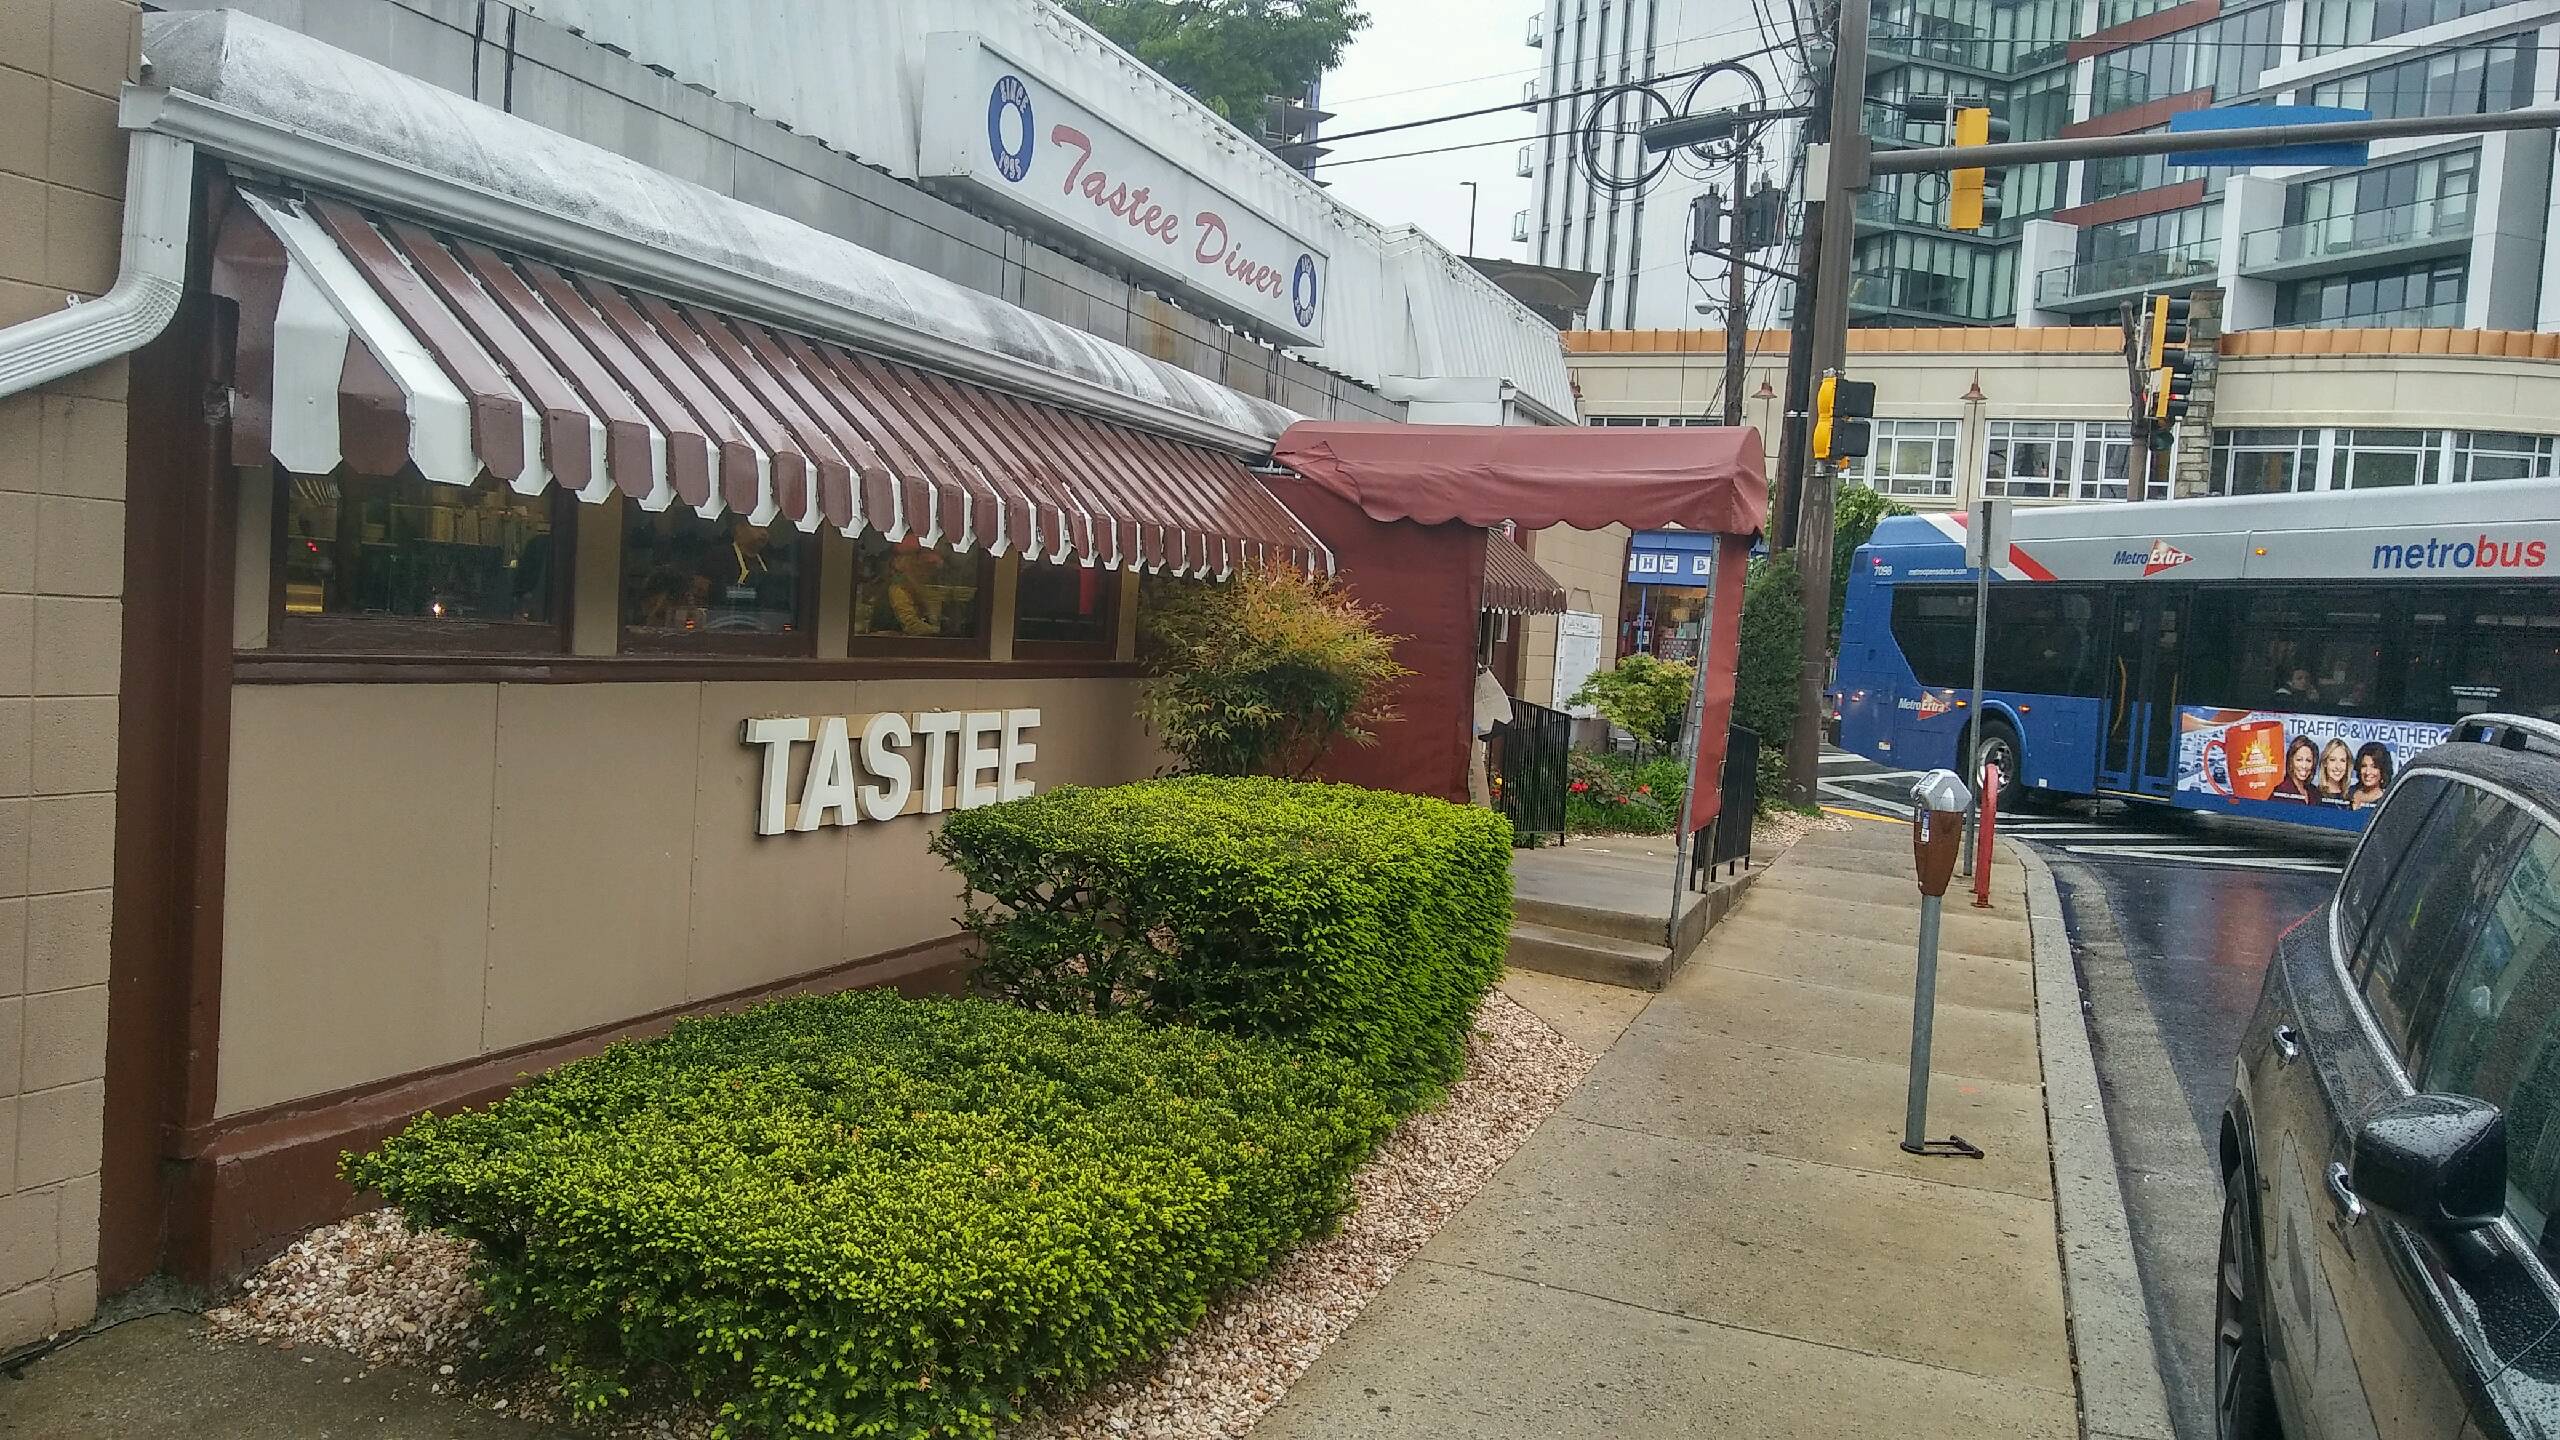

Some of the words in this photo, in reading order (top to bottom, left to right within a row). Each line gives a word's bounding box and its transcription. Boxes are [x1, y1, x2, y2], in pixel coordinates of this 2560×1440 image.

[999, 78, 1029, 113] SINCE
[1050, 123, 1179, 245] Tastee
[1195, 211, 1284, 299] Diner
[2113, 548, 2187, 565] MetroExtra
[2372, 534, 2547, 569] metrobus
[1897, 697, 1946, 713] MetroExtra
[2289, 718, 2348, 738] TRAFFIC
[2350, 725, 2361, 739] &
[2364, 725, 2440, 746] WEATHER
[745, 708, 1041, 836] TASTEE
